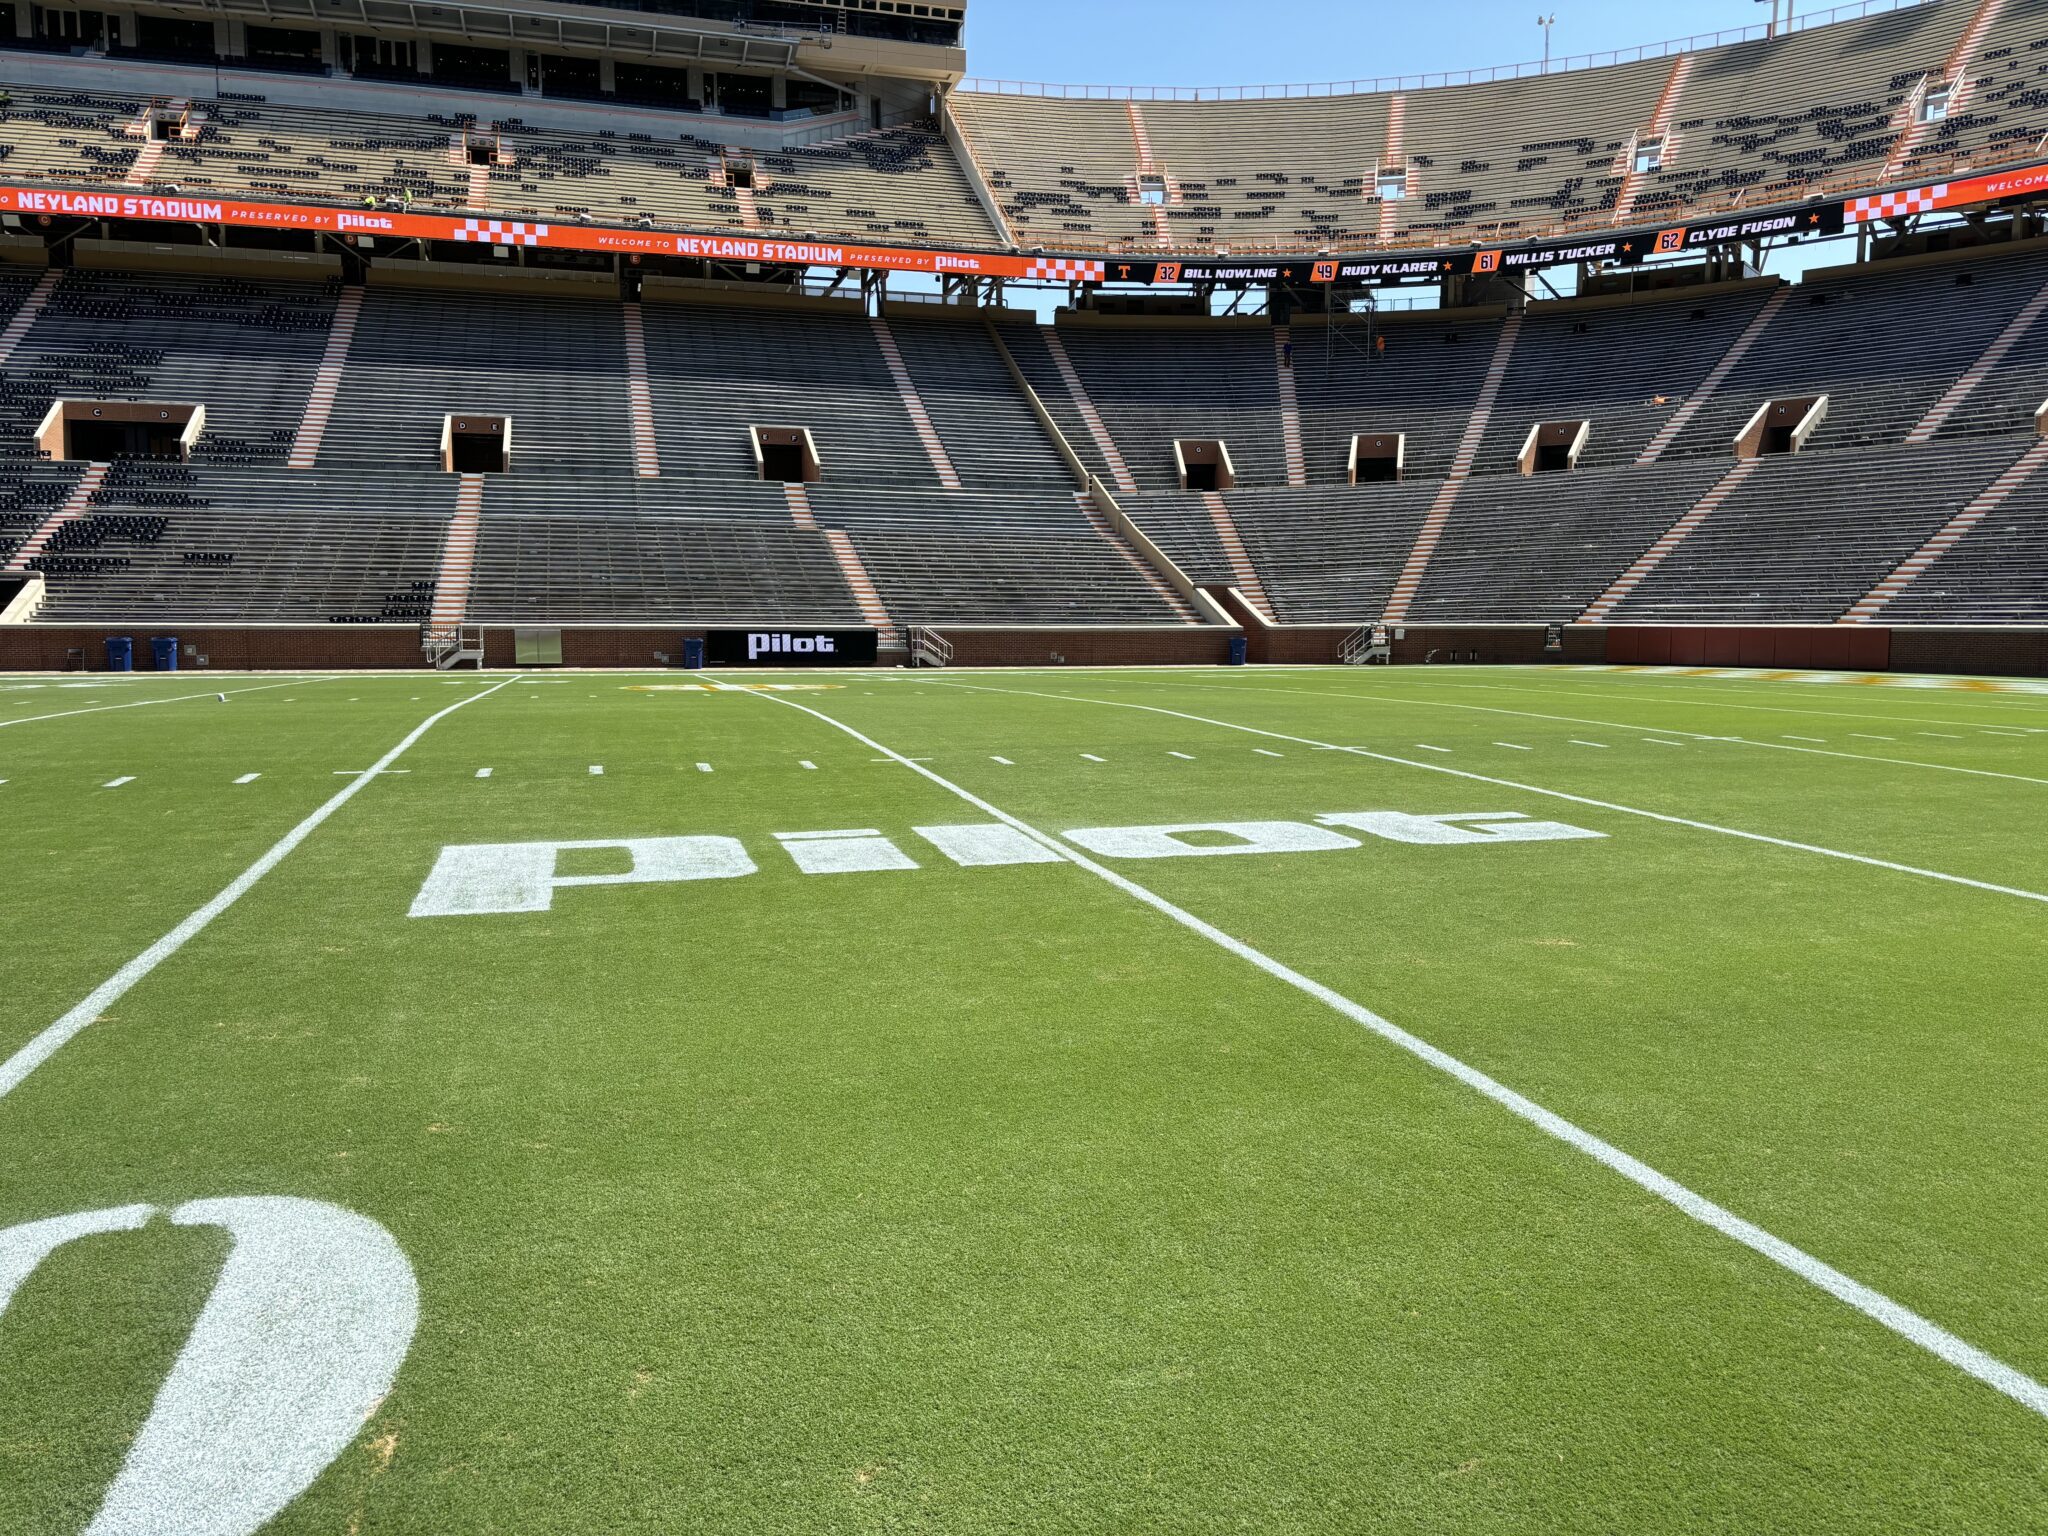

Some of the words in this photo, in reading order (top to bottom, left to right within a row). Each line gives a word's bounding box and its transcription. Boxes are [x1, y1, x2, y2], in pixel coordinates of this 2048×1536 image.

[18, 191, 119, 214] NEYLAND
[124, 197, 222, 220] STADIUM
[231, 210, 308, 223] PRESERVED
[314, 215, 330, 224] BY
[1661, 232, 1679, 249] 62
[1689, 225, 1738, 243] CLYDE
[1741, 216, 1796, 235] FUSON
[598, 237, 651, 247] WELCOME
[677, 237, 758, 257] NEYLAND
[763, 244, 842, 262] STADIUM
[849, 254, 912, 265] PRESERVED
[1480, 254, 1494, 269] 61
[1506, 252, 1554, 265] WILLIS
[1558, 243, 1616, 260] TUCKER
[1160, 266, 1175, 280] 32
[1184, 269, 1212, 279] BILL
[1215, 268, 1277, 279] NOWLING
[1317, 264, 1333, 279] 49
[1341, 265, 1380, 277] RUDY
[1382, 261, 1438, 274] KLARER
